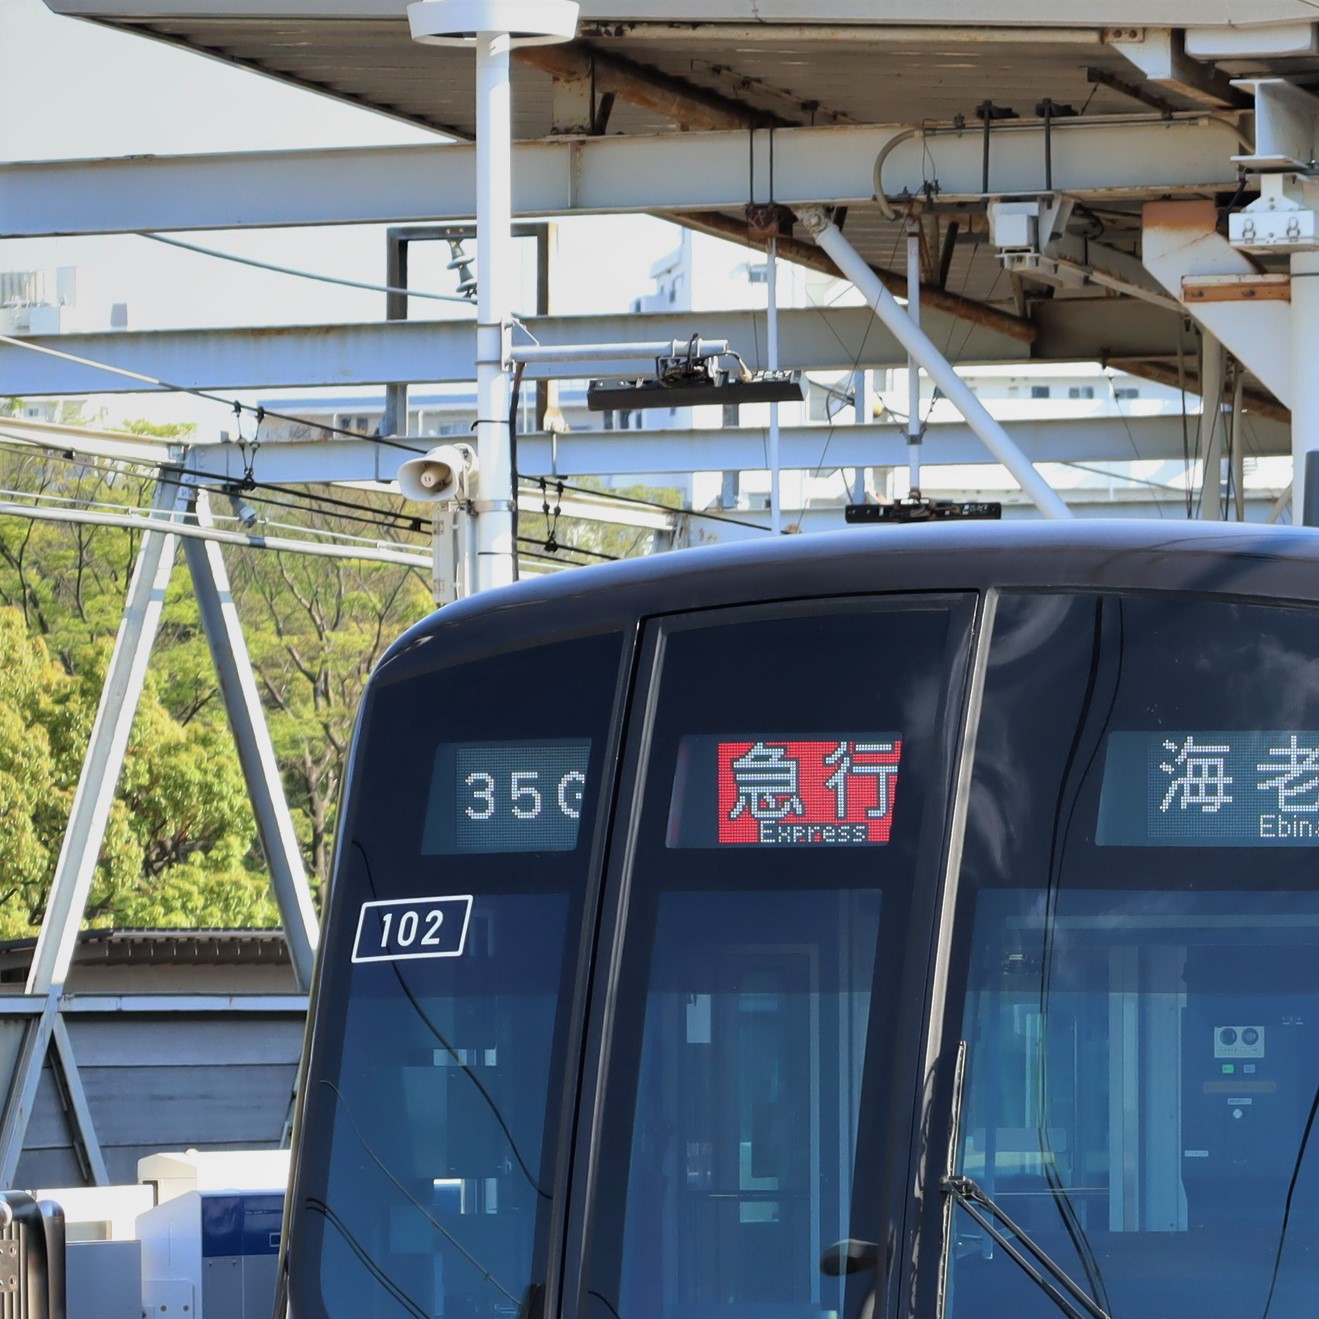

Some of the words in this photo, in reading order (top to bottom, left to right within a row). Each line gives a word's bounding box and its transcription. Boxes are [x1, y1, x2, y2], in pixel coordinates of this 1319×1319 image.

[727, 741, 900, 819] 急行
[758, 819, 867, 844] Express
[379, 908, 445, 949] 102
